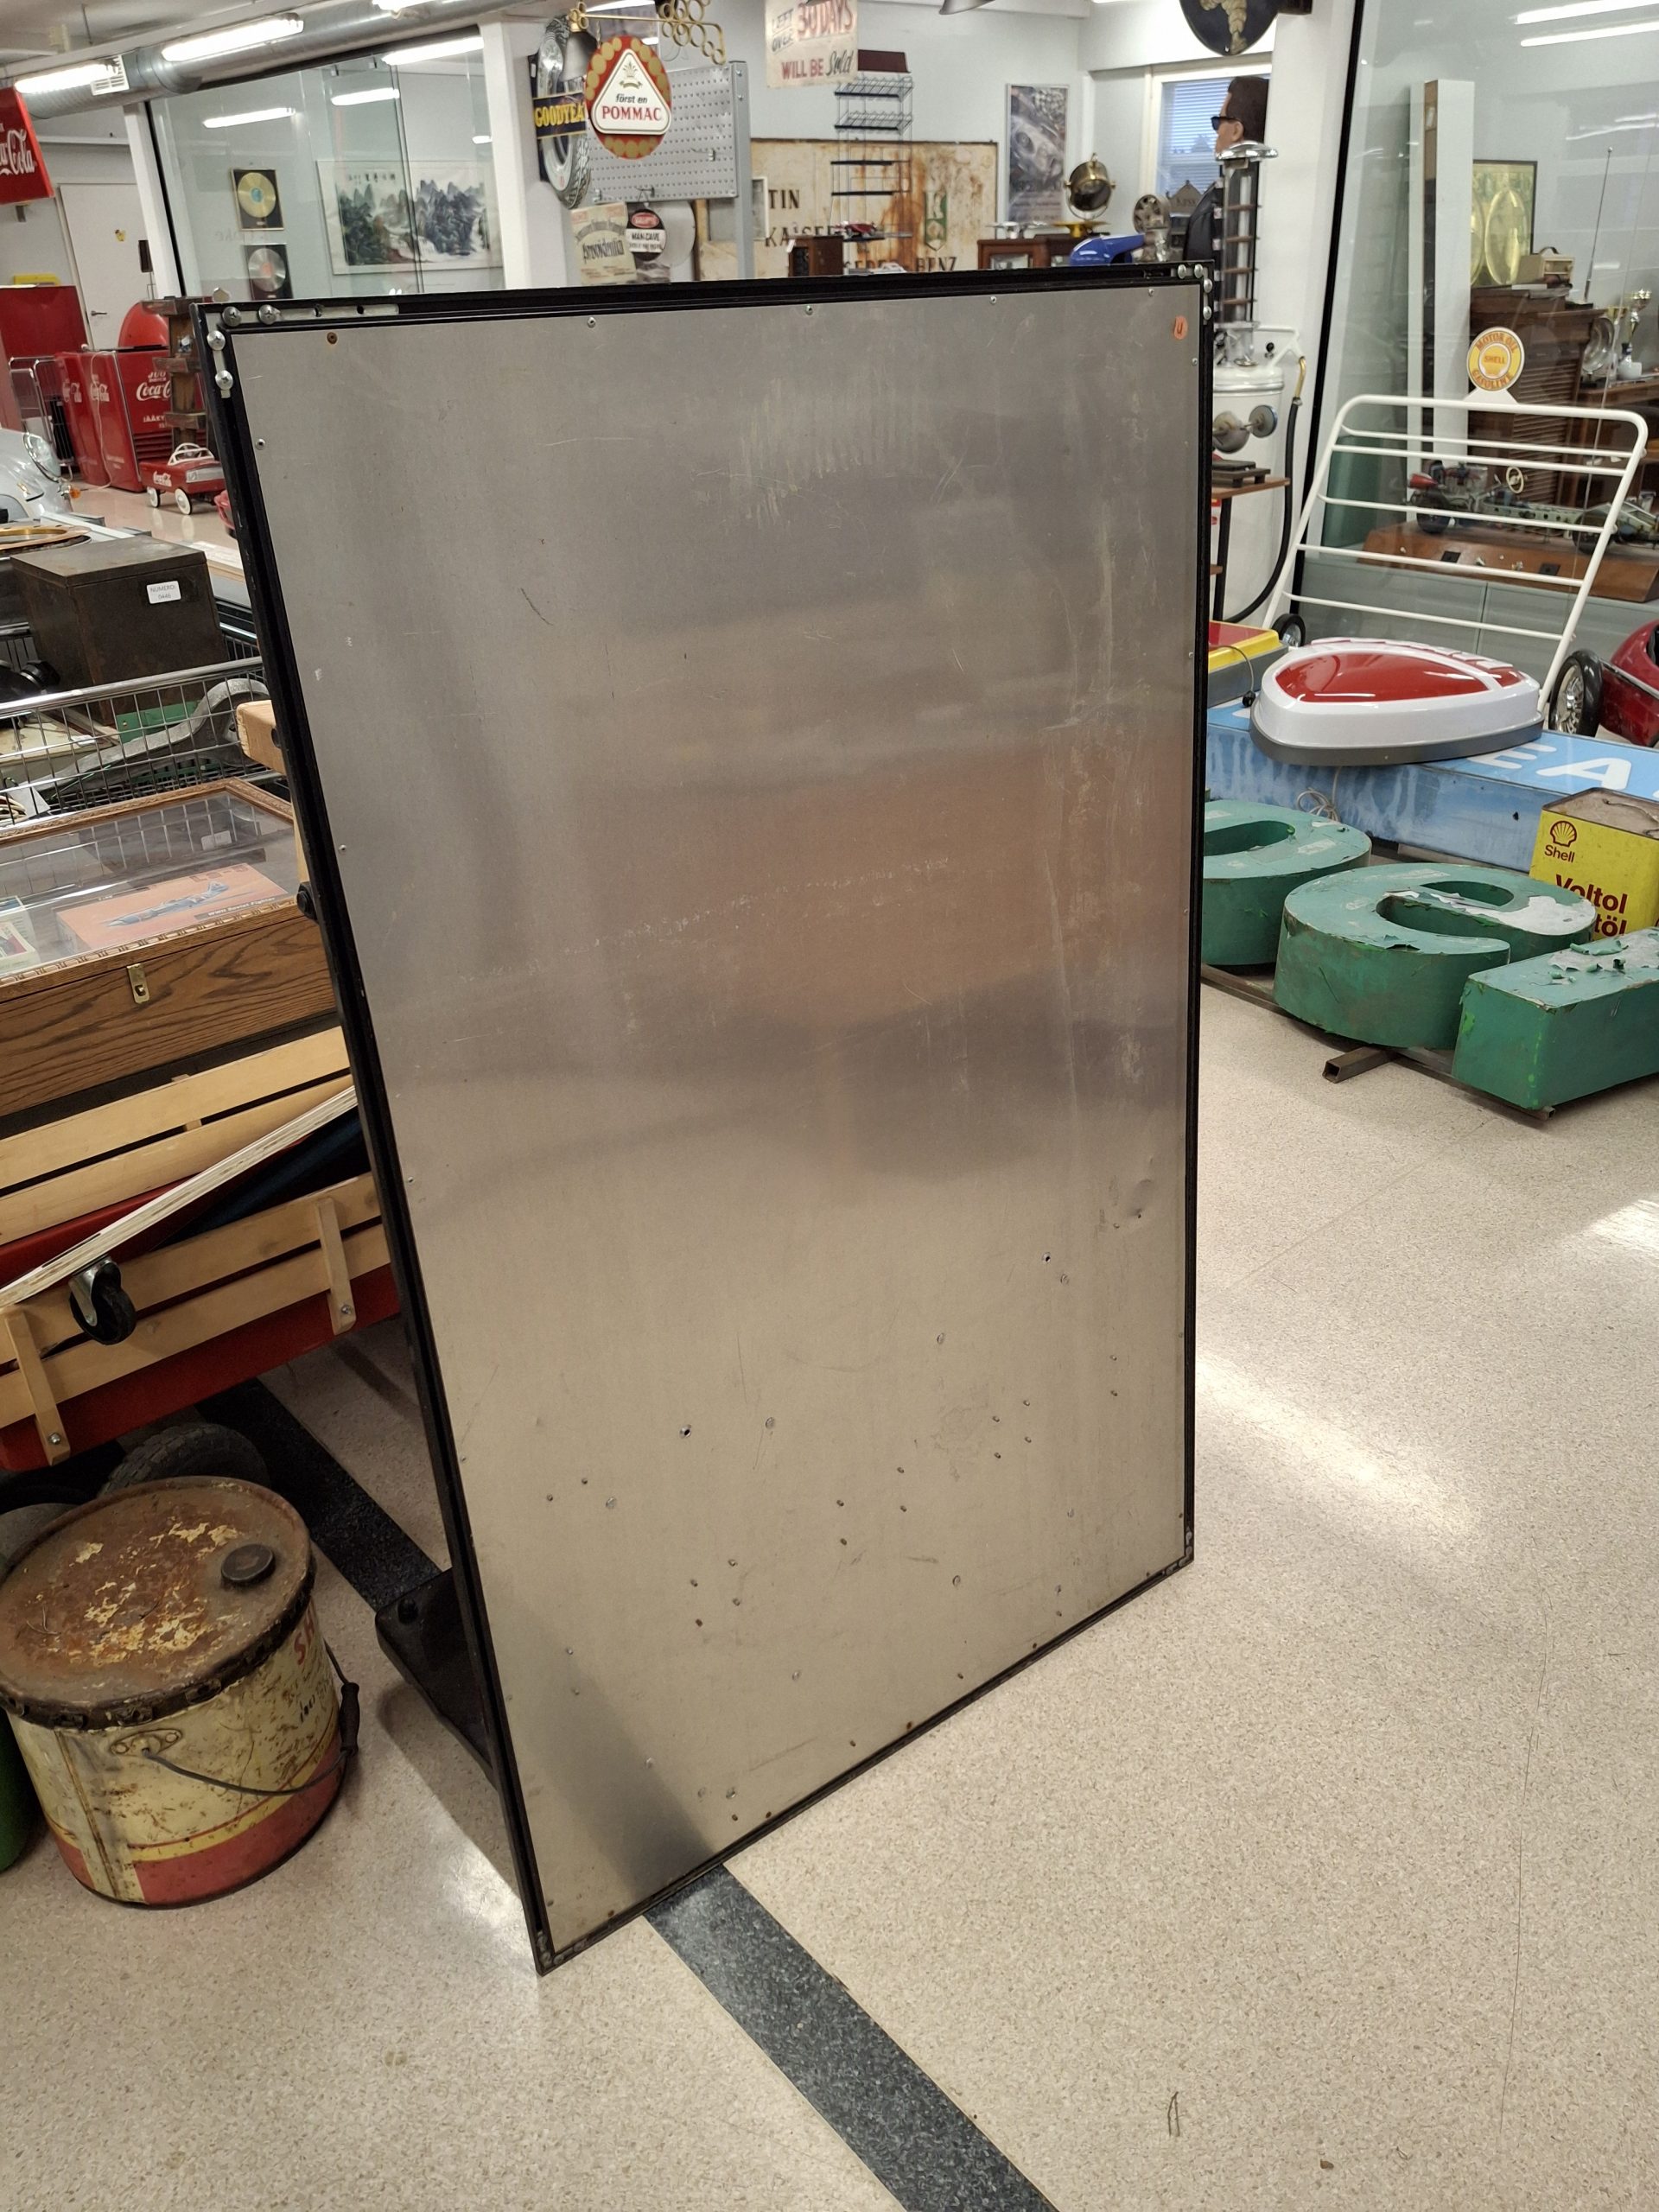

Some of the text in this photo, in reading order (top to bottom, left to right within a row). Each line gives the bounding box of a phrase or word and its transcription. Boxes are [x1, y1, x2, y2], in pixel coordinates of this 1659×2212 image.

[781, 49, 855, 79] WILL BE Sold
[616, 93, 635, 104] först
[535, 101, 585, 127] GOODYEA
[602, 106, 662, 121] POMMAC
[768, 189, 800, 209] TIN
[1483, 355, 1505, 364] SHELL
[1544, 844, 1575, 862] Shell
[1555, 874, 1628, 914] Voltol
[1594, 913, 1628, 937] töl
